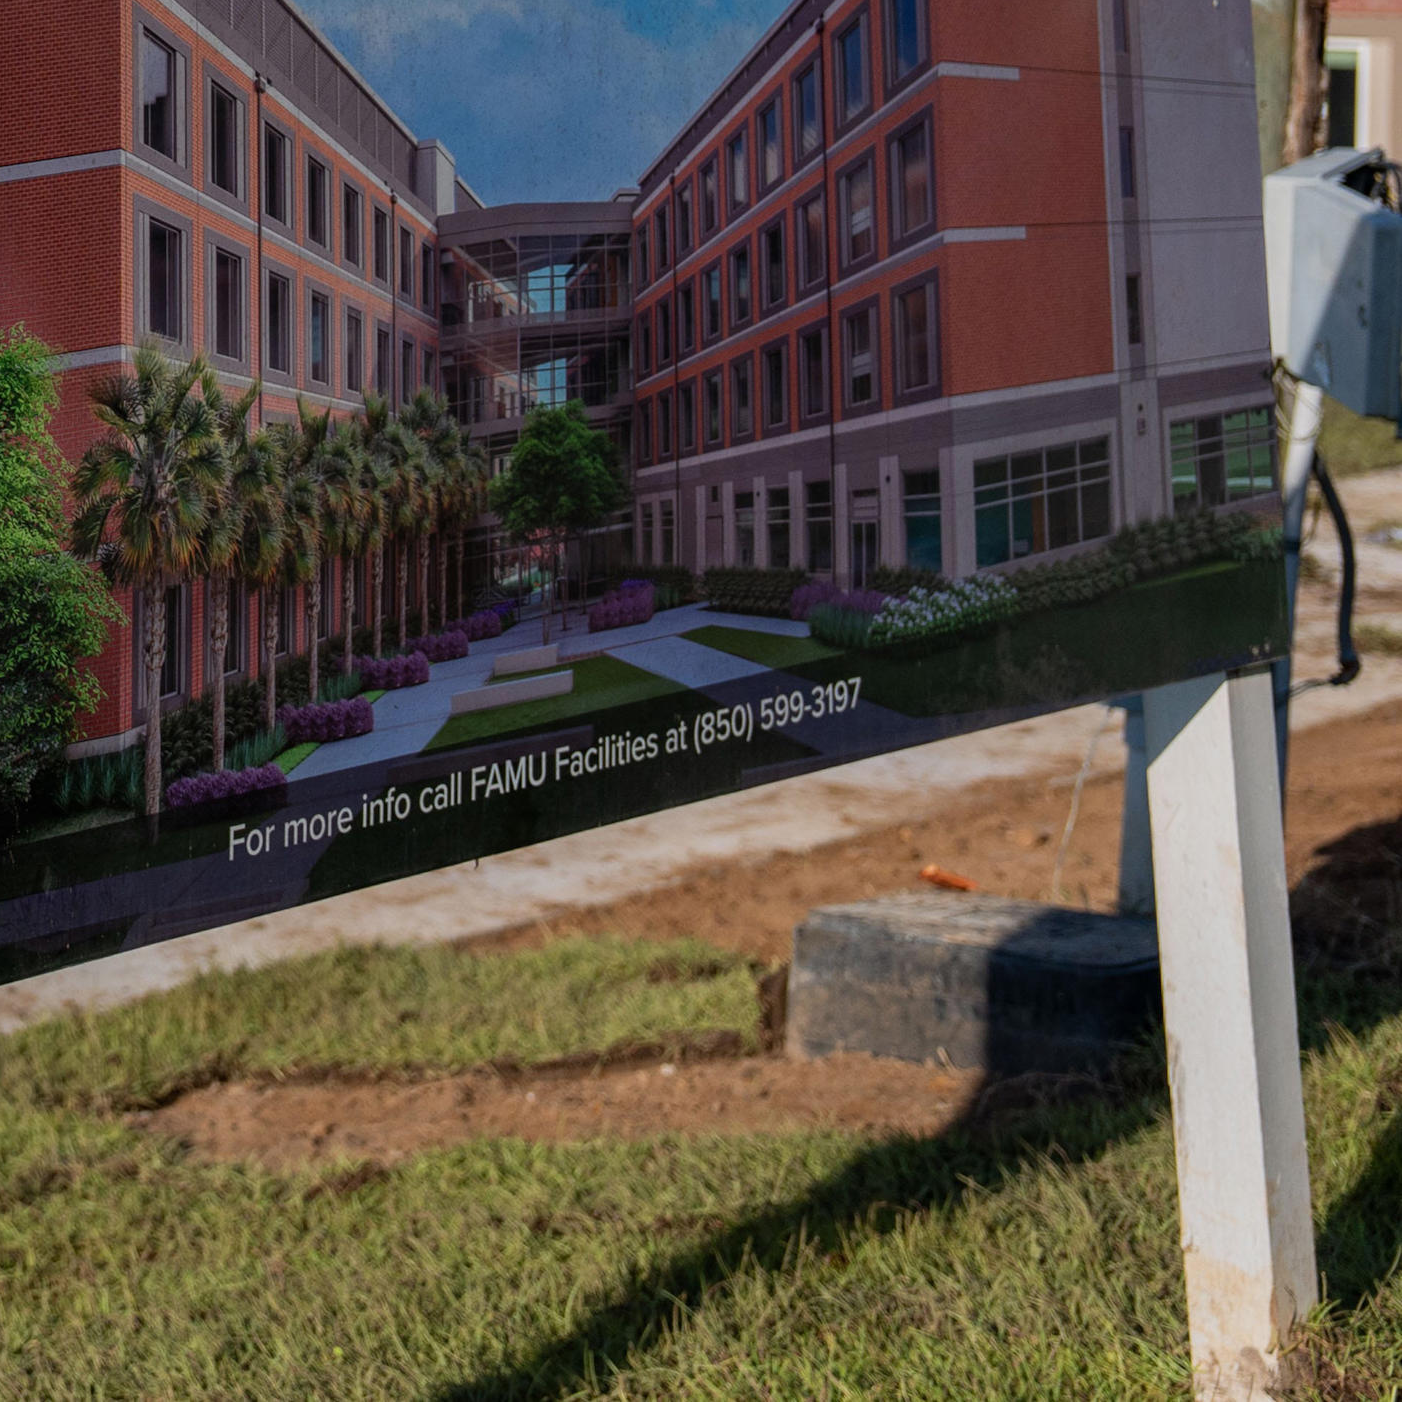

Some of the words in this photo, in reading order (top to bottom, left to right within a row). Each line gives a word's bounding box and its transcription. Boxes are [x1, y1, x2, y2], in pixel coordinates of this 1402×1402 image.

[228, 823, 276, 861] For
[284, 806, 353, 848] more
[362, 787, 411, 828] info
[419, 771, 462, 814] call
[471, 748, 547, 802] FAMU
[554, 731, 659, 781] Facilities
[665, 720, 688, 754] at
[694, 702, 754, 755] (850)
[760, 676, 862, 731] 599-3197
